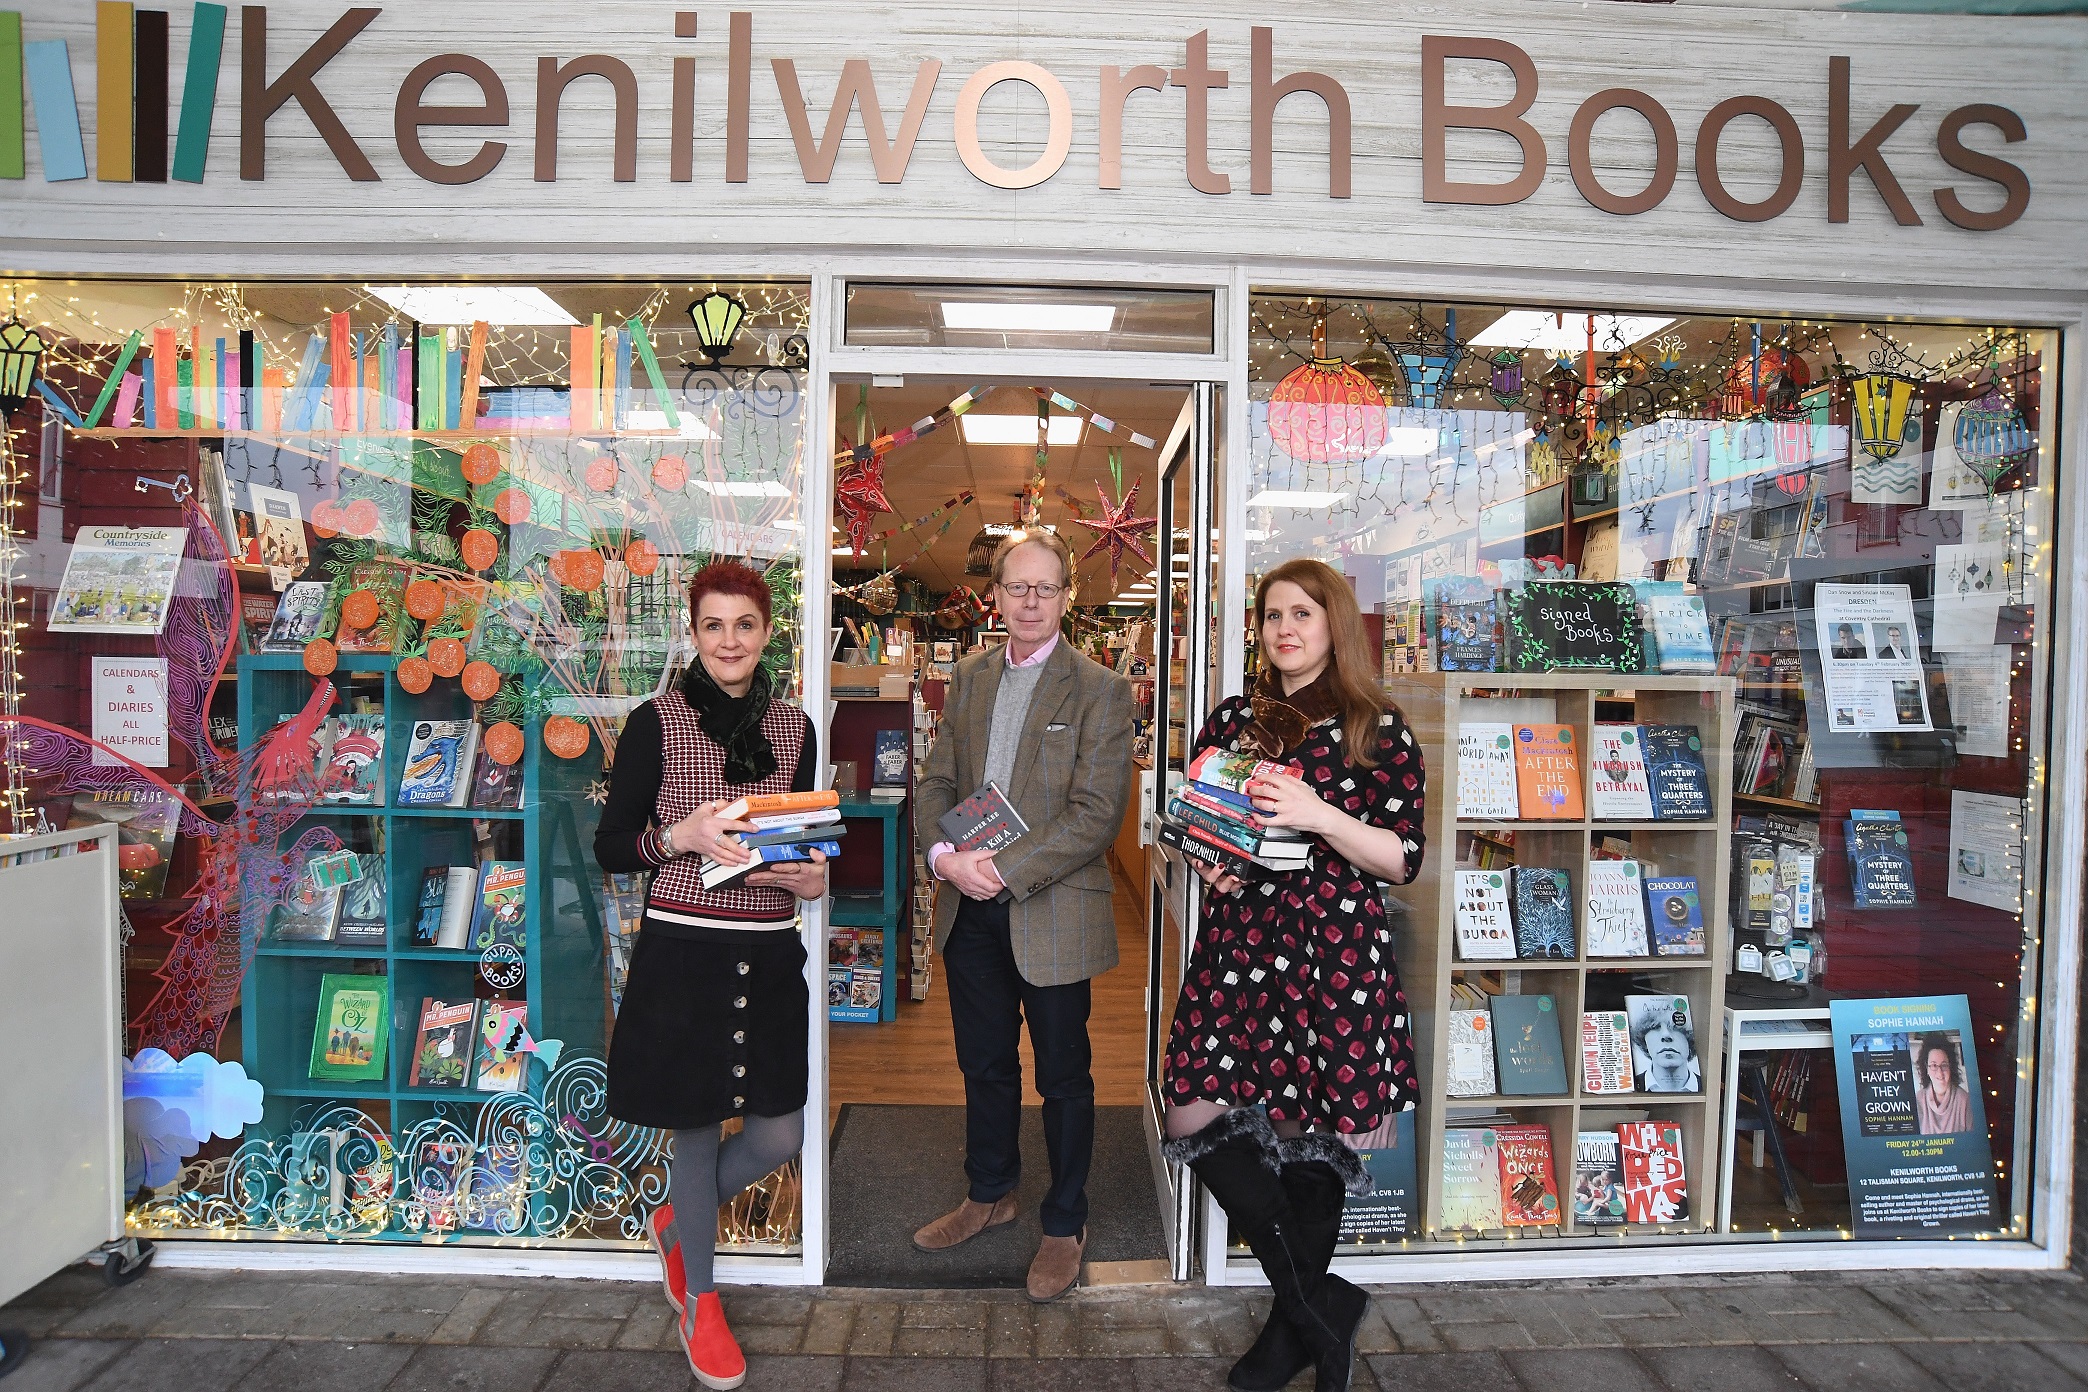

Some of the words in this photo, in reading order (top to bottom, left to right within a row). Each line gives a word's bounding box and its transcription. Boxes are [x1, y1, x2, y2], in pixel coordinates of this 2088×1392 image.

[240, 5, 1352, 200] Kenilworth
[1422, 34, 2032, 232] Books
[1608, 482, 1631, 494] autiful
[1631, 472, 1655, 485] Books
[1508, 511, 1525, 523] Quirky
[93, 528, 168, 541] Countryside
[722, 529, 773, 544] CALENDARS
[103, 538, 151, 548] Memories
[292, 587, 319, 598] LAST
[1450, 598, 1486, 607] DEEPLIGHT
[1659, 610, 1703, 618] TRICK
[1565, 624, 1614, 647] Books
[1668, 632, 1703, 640] TIME
[1776, 657, 1801, 666] UNUSUAL
[102, 668, 159, 678] CALENDARS
[126, 685, 135, 694] &
[108, 701, 154, 713] DIARIES
[122, 720, 139, 730] ALL
[208, 717, 227, 728] LEX
[101, 735, 161, 746] HALF-PRICE
[1603, 739, 1622, 749] THE
[1489, 751, 1509, 763] AWAY
[1525, 756, 1575, 770] AFTER
[1537, 771, 1565, 782] THE
[1660, 769, 1696, 777] MYSTERY
[1537, 784, 1569, 797] END
[1595, 782, 1645, 792] BETRAYAL
[94, 790, 131, 802] DREAM
[133, 791, 163, 803] CARS
[410, 791, 446, 800] Dragons
[1662, 791, 1704, 799] QUARTERS
[751, 801, 782, 809] Mackintosh
[1487, 806, 1508, 814] GAYLE
[962, 821, 987, 840] HARPER
[987, 811, 1000, 823] LEE
[1179, 807, 1194, 821] LEE
[1194, 814, 1218, 833] CHILD
[1219, 828, 1230, 838] BLUE
[987, 834, 1004, 849] Kill
[1003, 829, 1011, 838] A
[1181, 835, 1220, 865] THORNHILL
[1867, 861, 1902, 869] MYSTERY
[500, 871, 525, 881] PENGU
[1465, 874, 1489, 885] IT'S
[1874, 874, 1900, 882] THREE
[1648, 881, 1695, 891] CHOCOLAT
[1867, 882, 1909, 890] QUARTERS
[1465, 888, 1492, 898] NOT
[1459, 902, 1504, 912] ABOUT
[1588, 899, 1635, 921] Strawberry
[1470, 915, 1496, 925] THE
[1463, 929, 1509, 940] BURQA
[1597, 916, 1628, 943] Thief
[484, 946, 519, 964] GUPPY
[485, 965, 521, 986] BOOKS
[828, 973, 847, 981] SPACE
[426, 1012, 438, 1022] MR.
[439, 1006, 470, 1019] PENGUIN
[1874, 1005, 1899, 1014] BOOK
[1902, 1004, 1937, 1013] SIGNING
[1868, 1017, 1903, 1028] SOPHIE
[1905, 1016, 1944, 1026] HANNAH
[1582, 1013, 1598, 1047] PEOPLE
[1584, 1050, 1602, 1091] COMMON
[1861, 1070, 1906, 1083] HAVEN'T
[1871, 1086, 1900, 1097] THEY
[1865, 1101, 1911, 1114] GROWN
[1864, 1115, 1886, 1123] SOPHIE
[1443, 1139, 1470, 1149] David
[1885, 1140, 1910, 1148] FRIDAY
[1925, 1138, 1955, 1146] JANUARY
[1443, 1151, 1484, 1160] Nicholls
[1498, 1143, 1549, 1159] Wizards
[1577, 1143, 1617, 1162] OWBORN
[1901, 1148, 1944, 1157] 12.00-1.30PM
[1443, 1162, 1473, 1172] Sweet
[1507, 1160, 1544, 1175] ONCE
[1623, 1148, 1683, 1192] RED
[1890, 1167, 1934, 1176] KENILWORTH
[1934, 1165, 1958, 1173] BOOKS
[1443, 1174, 1481, 1183] Sorrow
[1900, 1176, 1926, 1184] SQUARE,
[1926, 1173, 1964, 1182] KENILWORTH,
[1964, 1172, 1975, 1180] CV8
[1626, 1180, 1687, 1223] WAS
